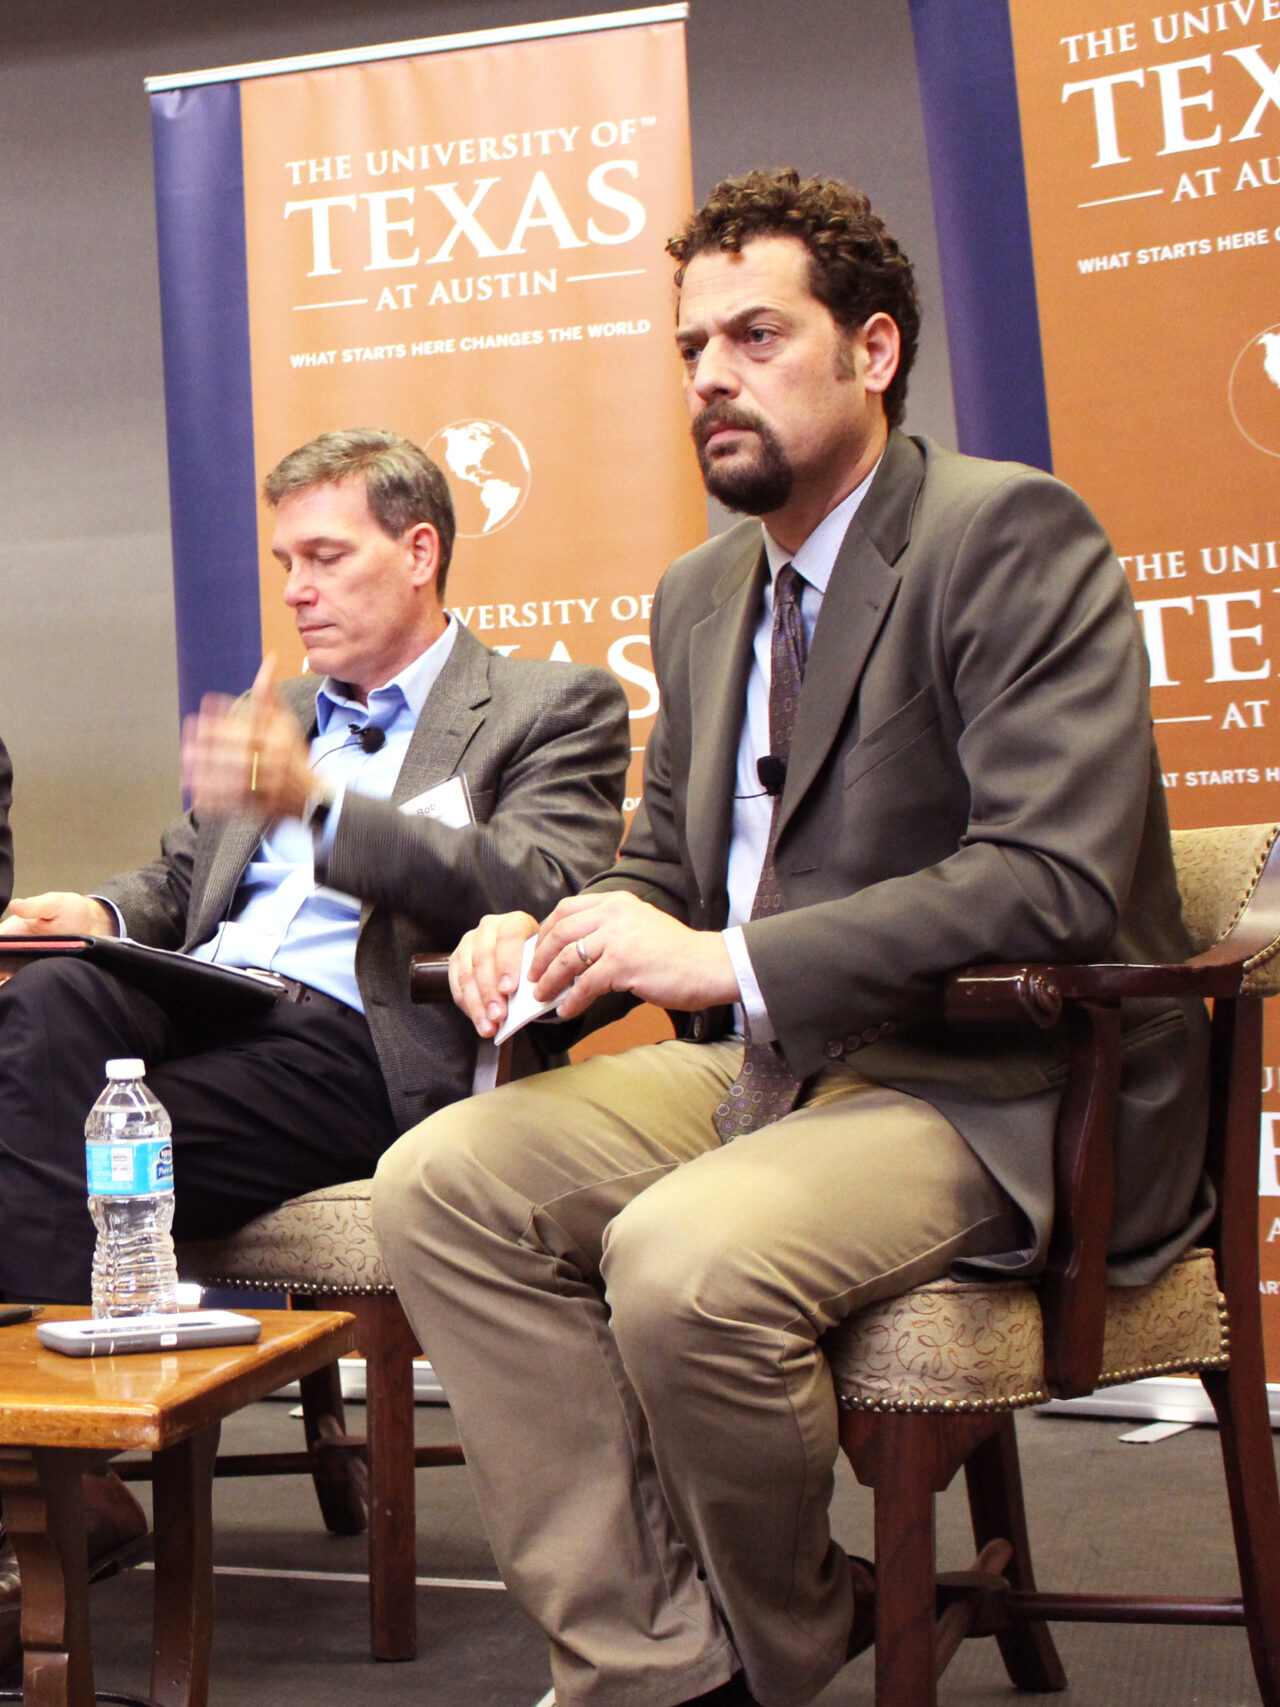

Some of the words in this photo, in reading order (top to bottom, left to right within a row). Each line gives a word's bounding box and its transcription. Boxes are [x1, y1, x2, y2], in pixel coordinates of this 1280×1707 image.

[1060, 23, 1137, 63] THE
[285, 155, 353, 185] THE
[365, 126, 579, 176] UNIVERSITY
[1172, 167, 1221, 202] AT
[284, 157, 646, 277] TEXAS
[1078, 252, 1131, 274] WHAT
[1136, 239, 1212, 264] STARTS
[1218, 229, 1269, 251] HERE
[375, 284, 417, 311] AT
[428, 269, 556, 305] AUSTIN
[290, 351, 337, 368] WHAT
[342, 345, 406, 362] STARTS
[411, 339, 456, 356] HERE
[460, 330, 544, 351] CHANGES
[547, 326, 582, 342] THE
[588, 320, 650, 338] WORLD
[451, 598, 600, 630] VERSITY
[1221, 700, 1269, 729] AT
[1186, 769, 1260, 786] STARTS
